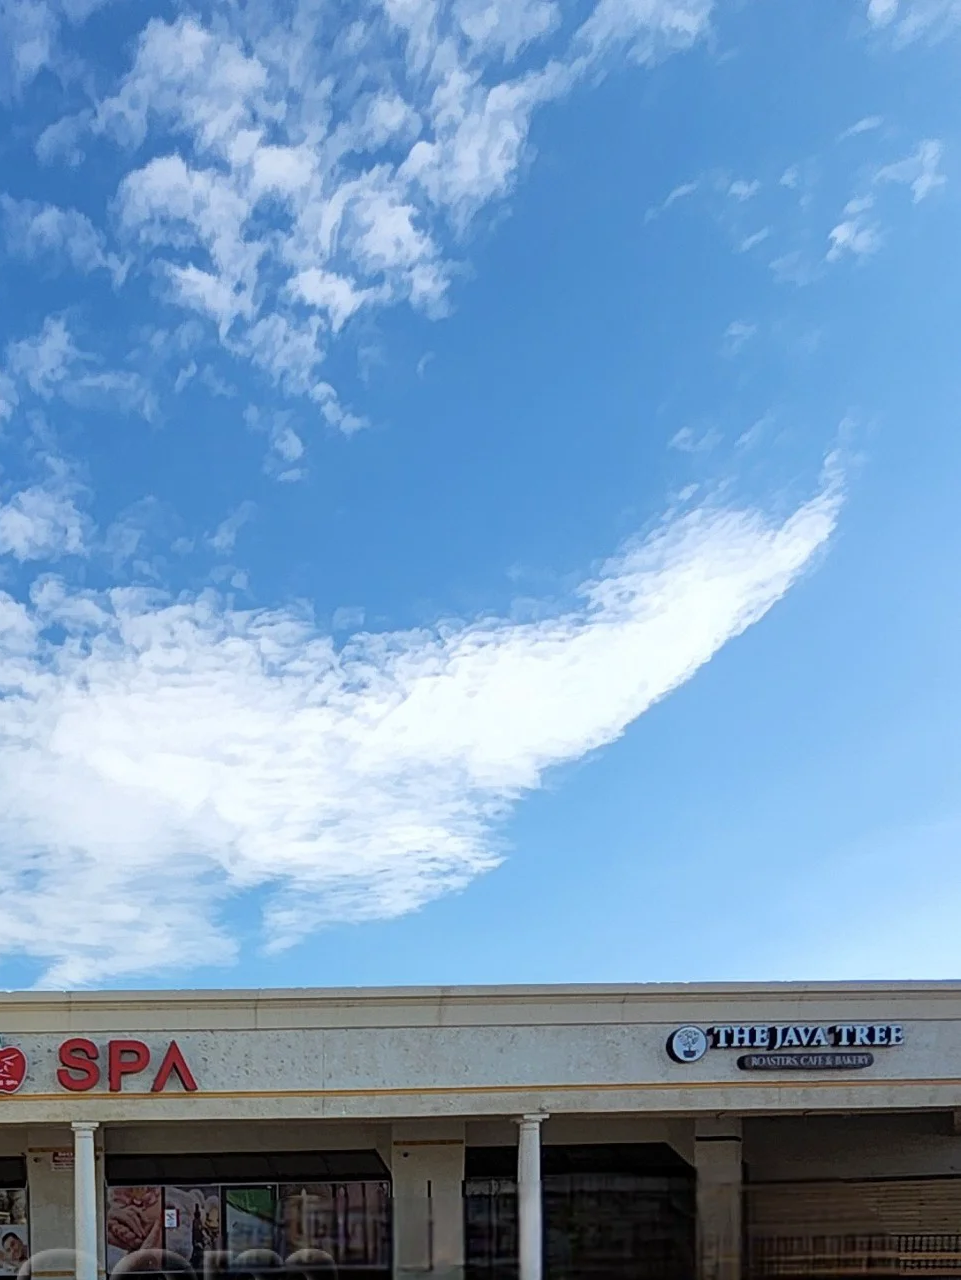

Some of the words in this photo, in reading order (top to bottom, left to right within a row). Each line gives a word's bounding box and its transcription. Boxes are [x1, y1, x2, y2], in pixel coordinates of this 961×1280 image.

[713, 1025, 768, 1047] THE
[772, 1025, 829, 1049] JAVA
[835, 1024, 905, 1046] TREE
[56, 1037, 199, 1092] SPA
[835, 1055, 870, 1066] BAKERY
